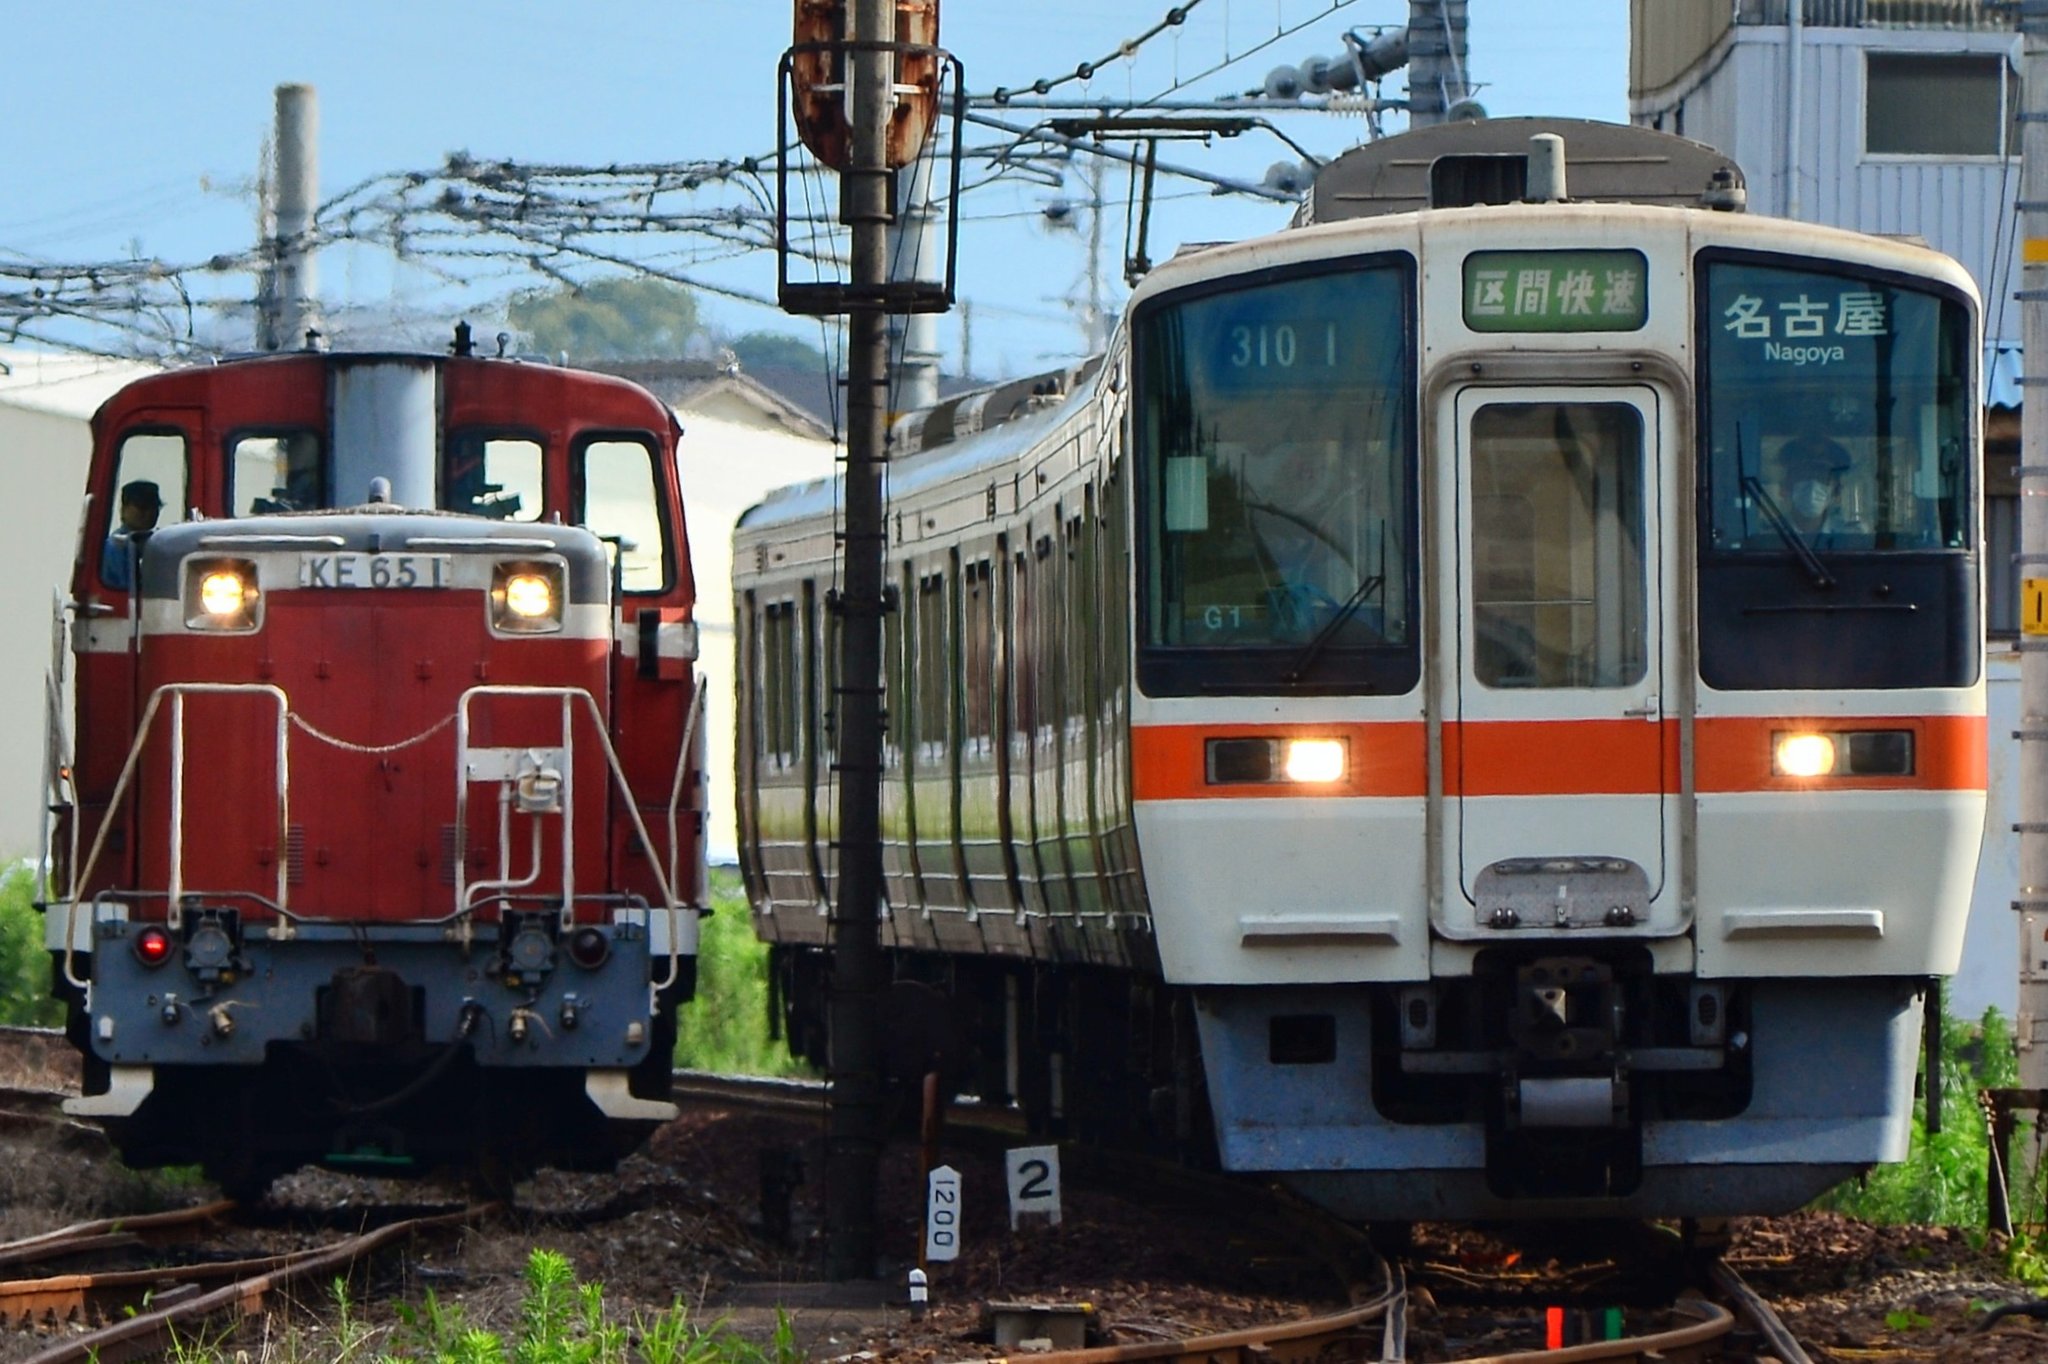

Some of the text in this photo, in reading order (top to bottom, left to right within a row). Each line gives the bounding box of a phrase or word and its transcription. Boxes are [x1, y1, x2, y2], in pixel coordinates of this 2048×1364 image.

[1472, 269, 1638, 316] 区間快速
[1724, 292, 1888, 338] 名古屋
[1231, 324, 1296, 367] 310
[1764, 342, 1844, 366] Nagoya
[1018, 1159, 1053, 1199] 2
[933, 1180, 955, 1247] 1200
